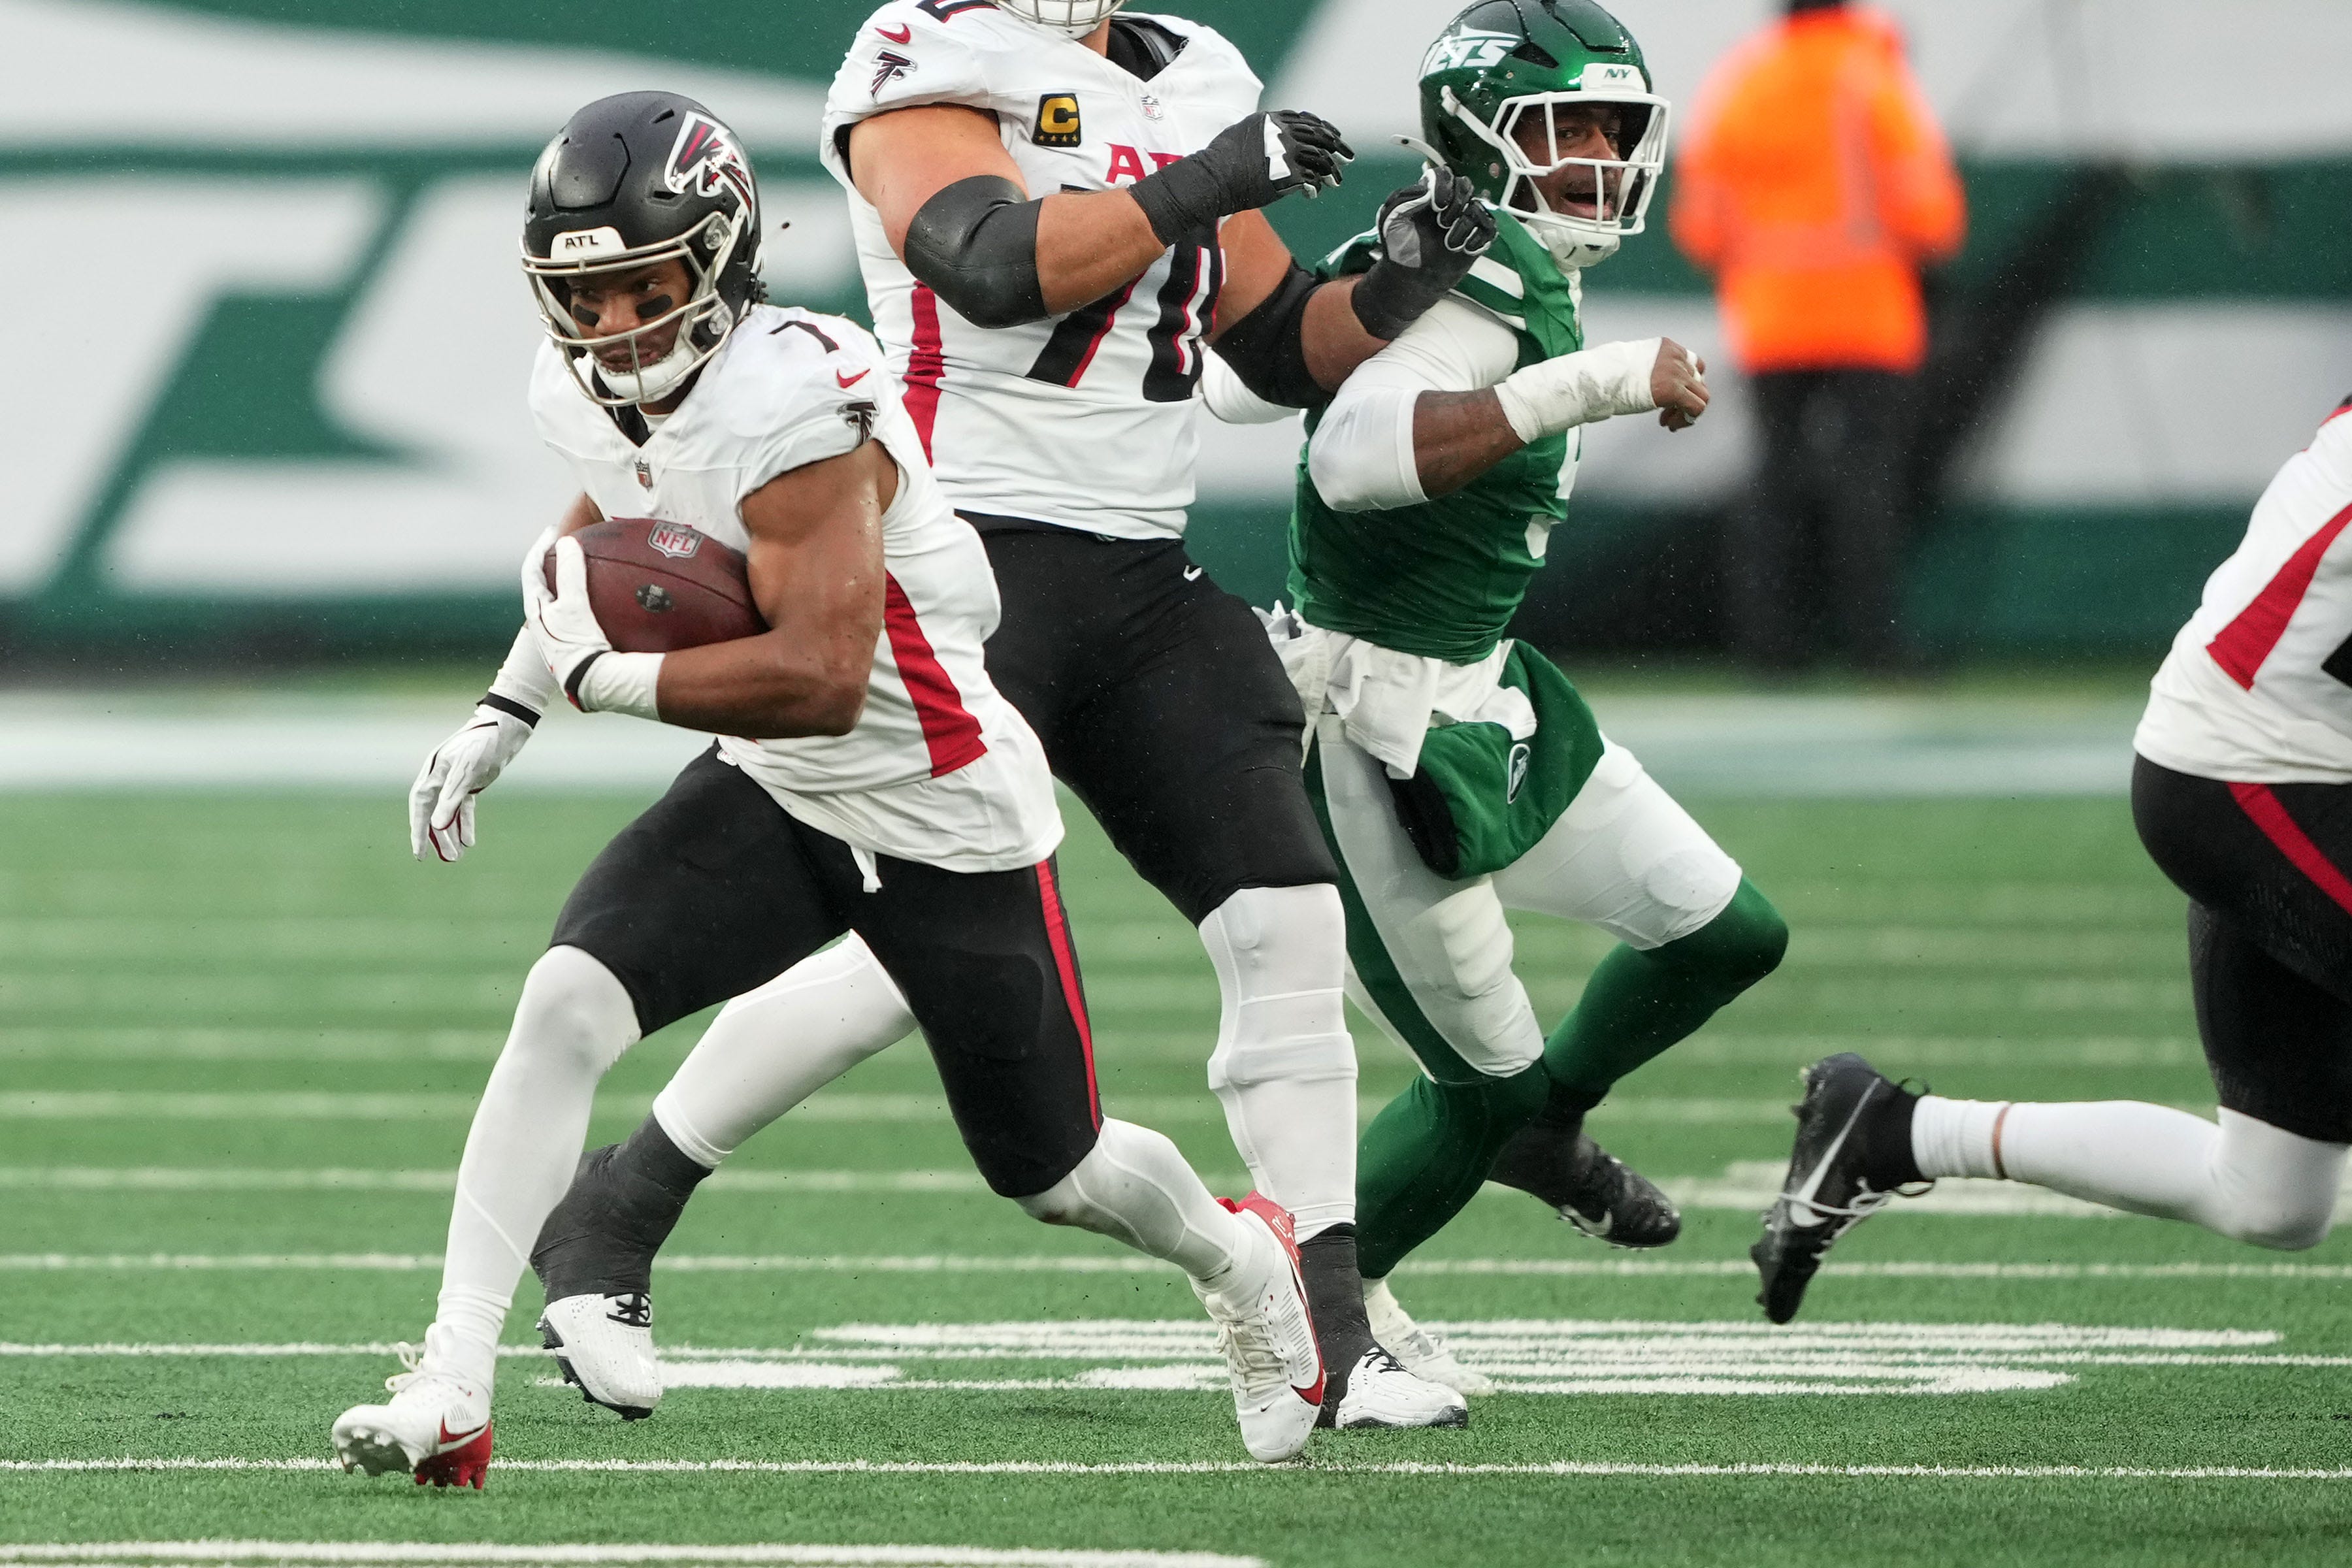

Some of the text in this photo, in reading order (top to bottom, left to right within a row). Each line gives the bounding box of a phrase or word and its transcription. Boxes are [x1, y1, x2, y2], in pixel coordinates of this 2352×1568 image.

[1605, 69, 1631, 78] NY
[1041, 97, 1079, 133] C
[565, 235, 599, 248] ATL
[655, 530, 691, 552] NFL
